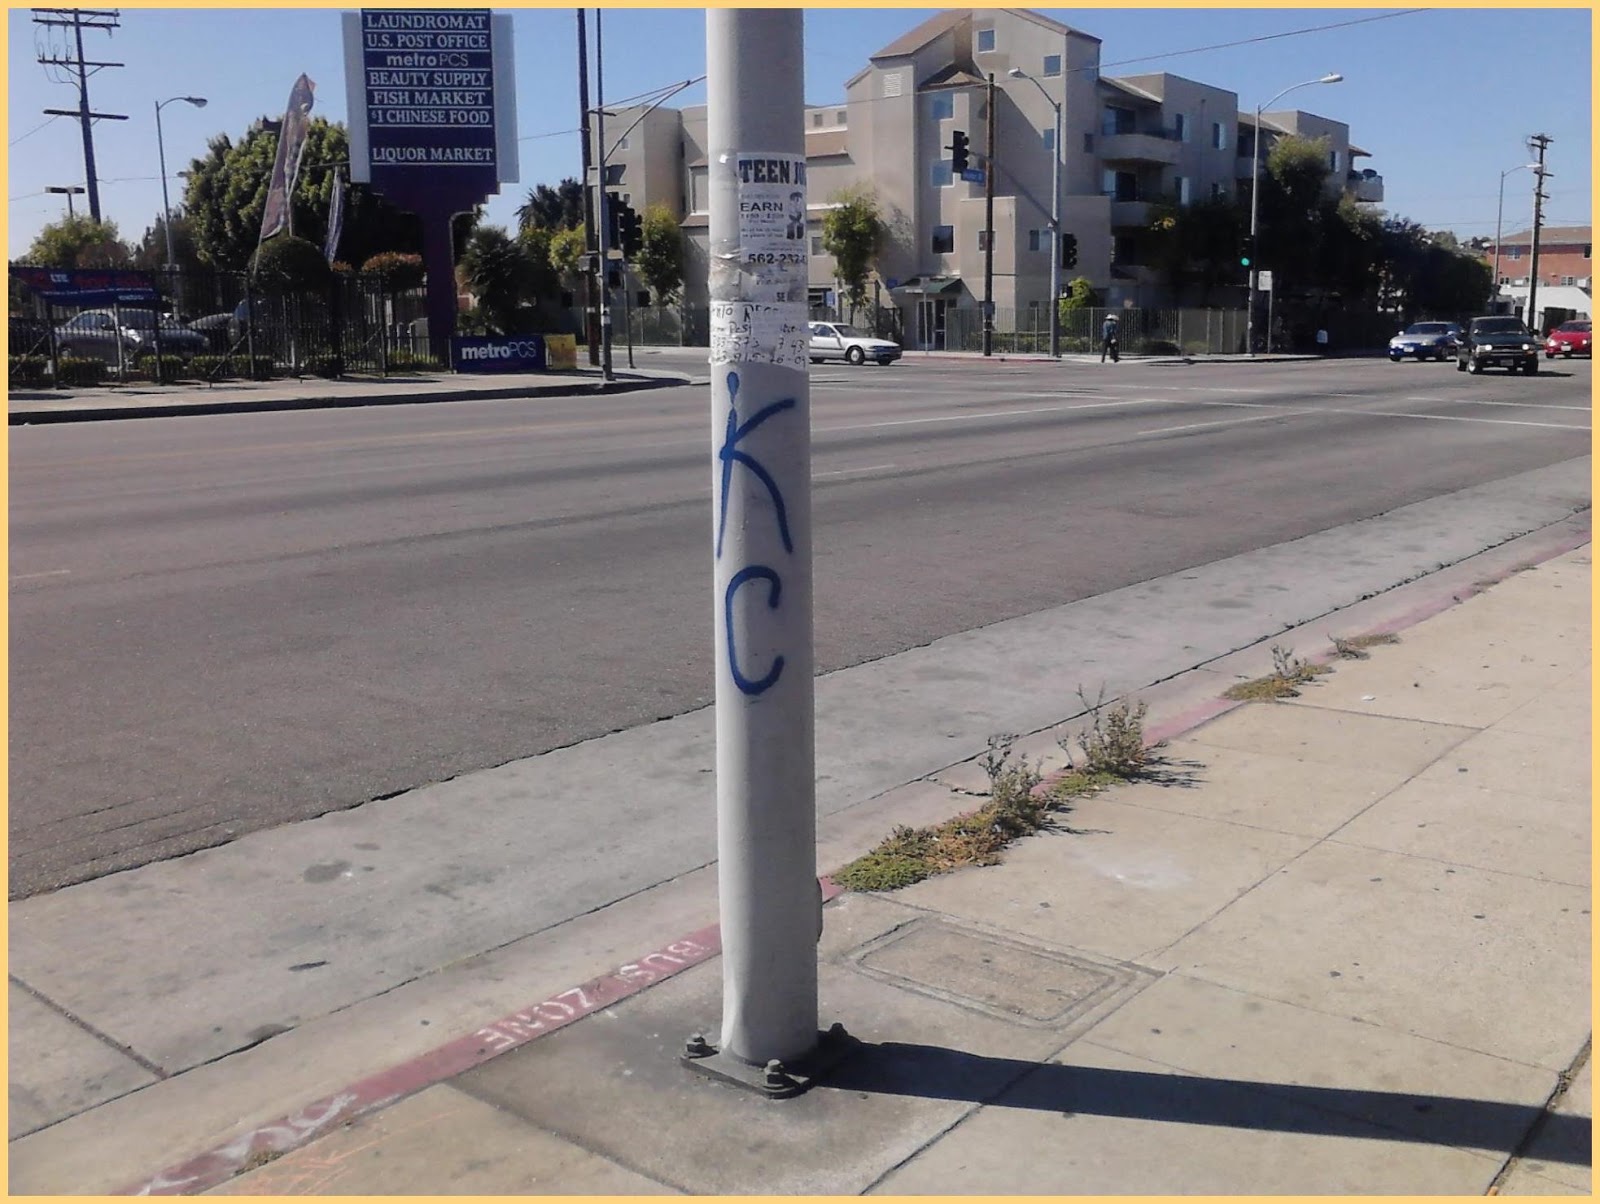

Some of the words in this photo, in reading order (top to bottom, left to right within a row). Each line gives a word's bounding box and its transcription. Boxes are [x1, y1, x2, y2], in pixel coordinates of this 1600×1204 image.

[366, 14, 486, 29] LAUNDROMAT
[367, 34, 394, 47] U.S.
[397, 34, 434, 48] POST
[437, 35, 488, 48] OFFICE
[370, 72, 429, 86] BEAUTY
[433, 73, 487, 86] SUPPLY
[373, 91, 409, 105] FISH
[414, 92, 486, 105] MARKET
[386, 110, 447, 124] CHINESE
[450, 110, 490, 124] FOOD
[373, 148, 427, 163] LIQUOR
[431, 148, 493, 161] MARKET
[738, 159, 790, 184] TEEN
[740, 202, 783, 211] EARN
[461, 341, 537, 360] metroPCS
[476, 987, 594, 1050] ZONE
